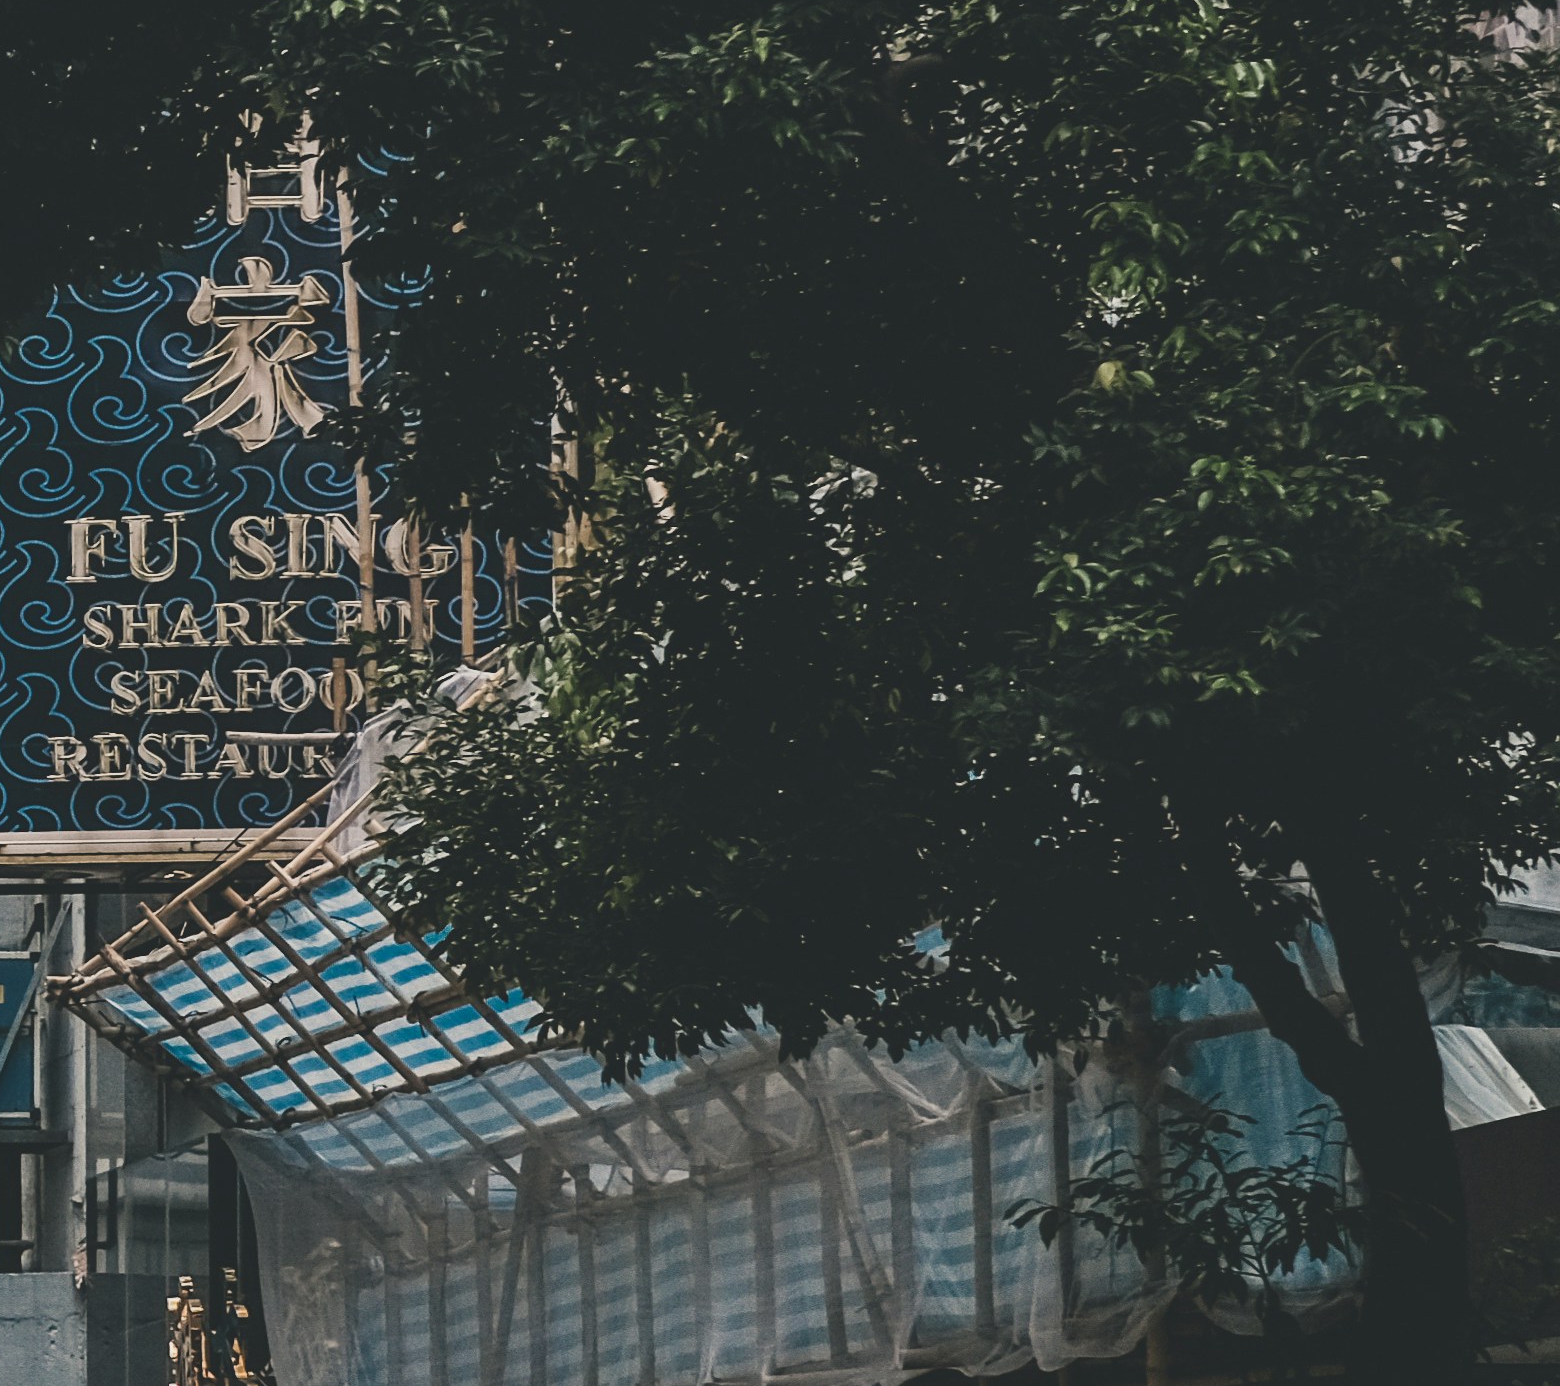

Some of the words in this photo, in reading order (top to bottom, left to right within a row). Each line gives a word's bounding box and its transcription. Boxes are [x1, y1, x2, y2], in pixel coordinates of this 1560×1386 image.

[64, 512, 186, 583] FU
[82, 600, 307, 649] SHARK
[110, 667, 365, 714] SEAFOO
[47, 732, 337, 782] RESTAUR
